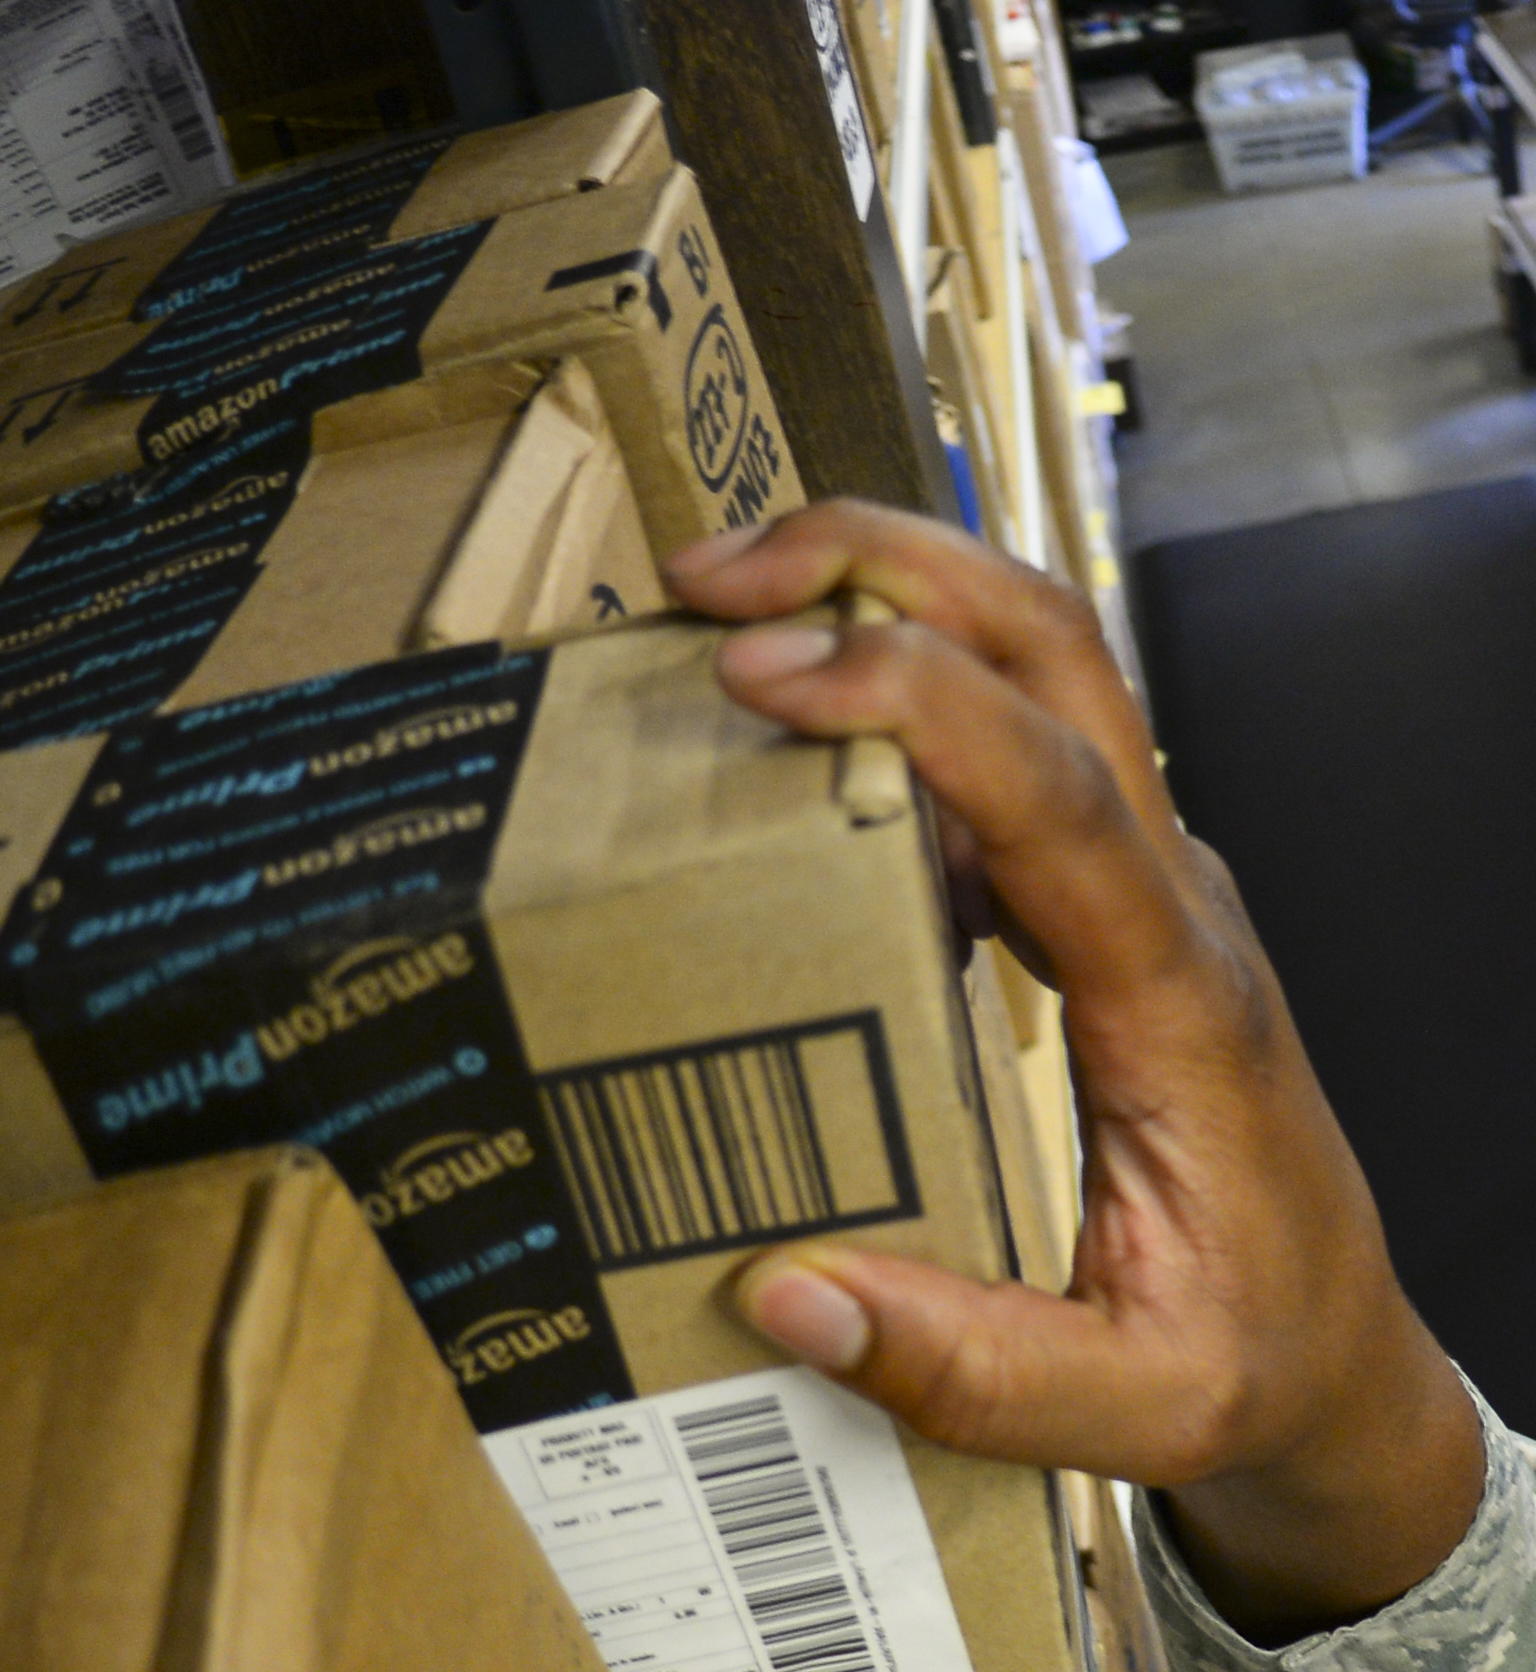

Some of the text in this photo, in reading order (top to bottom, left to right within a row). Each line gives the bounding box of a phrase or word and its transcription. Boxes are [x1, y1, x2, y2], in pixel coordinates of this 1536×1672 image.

[146, 377, 279, 460] amazon
[263, 804, 486, 887] amazon
[98, 932, 475, 1133] amazon Prime
